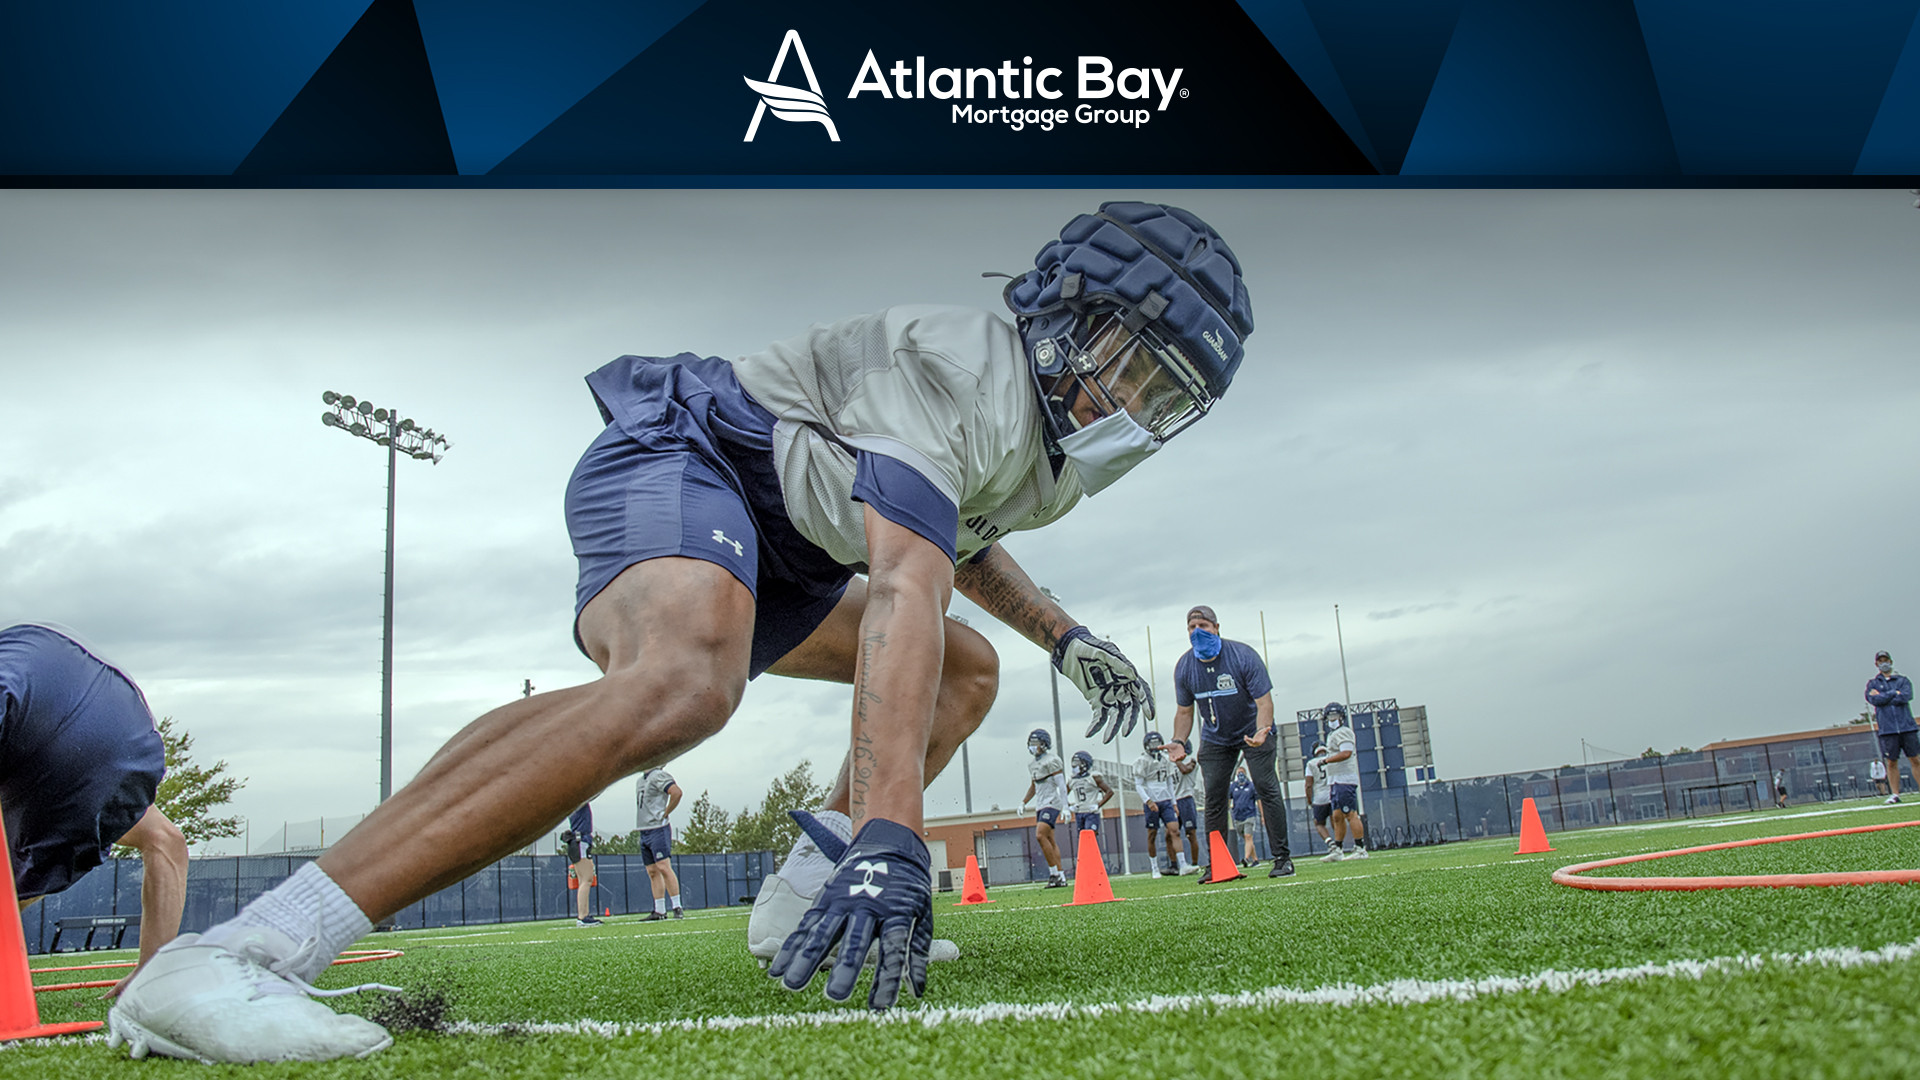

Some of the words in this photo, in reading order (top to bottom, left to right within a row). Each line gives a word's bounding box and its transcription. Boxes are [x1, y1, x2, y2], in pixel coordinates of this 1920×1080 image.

[1202, 330, 1228, 361] GUARDIAN
[857, 629, 887, 722] November
[1075, 785, 1087, 802] 15
